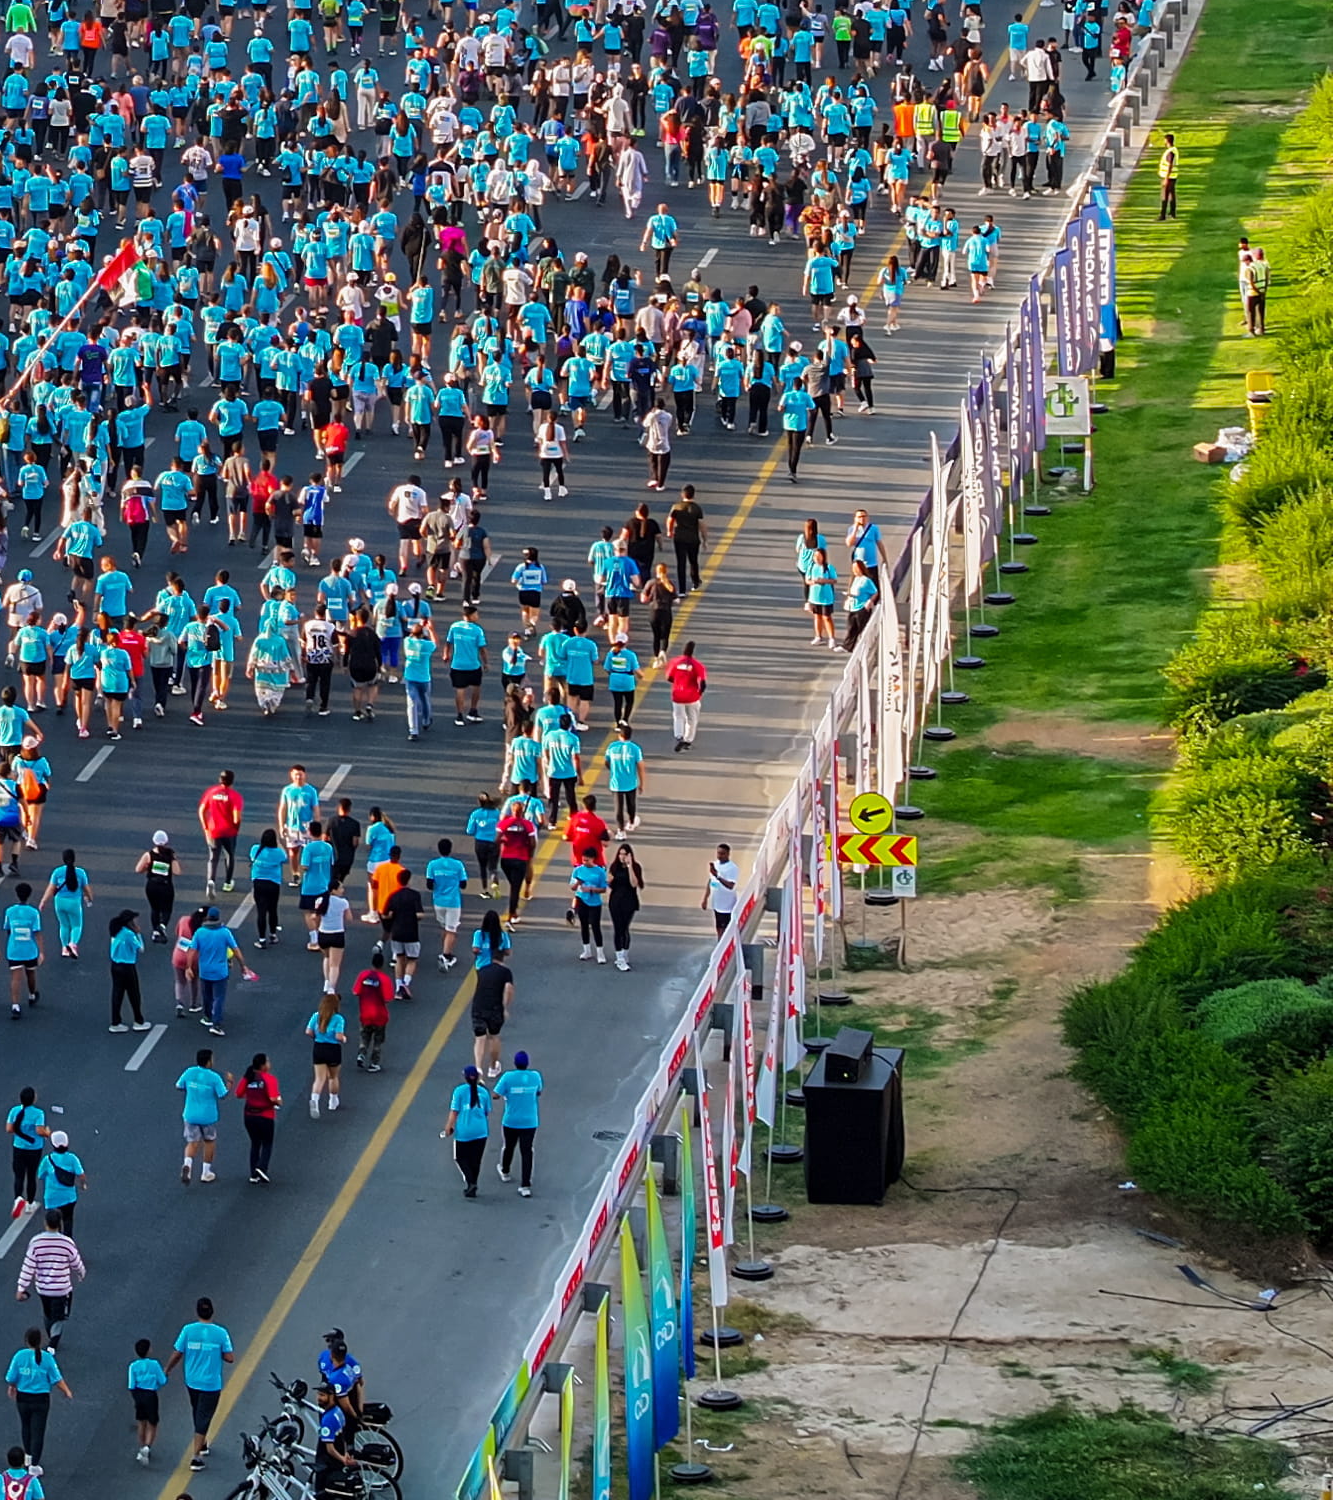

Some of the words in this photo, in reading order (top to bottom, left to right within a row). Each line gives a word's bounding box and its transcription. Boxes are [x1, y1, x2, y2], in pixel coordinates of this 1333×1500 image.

[1085, 219, 1096, 294] WORLD
[1084, 296, 1094, 322] DP
[311, 634, 327, 649] 18
